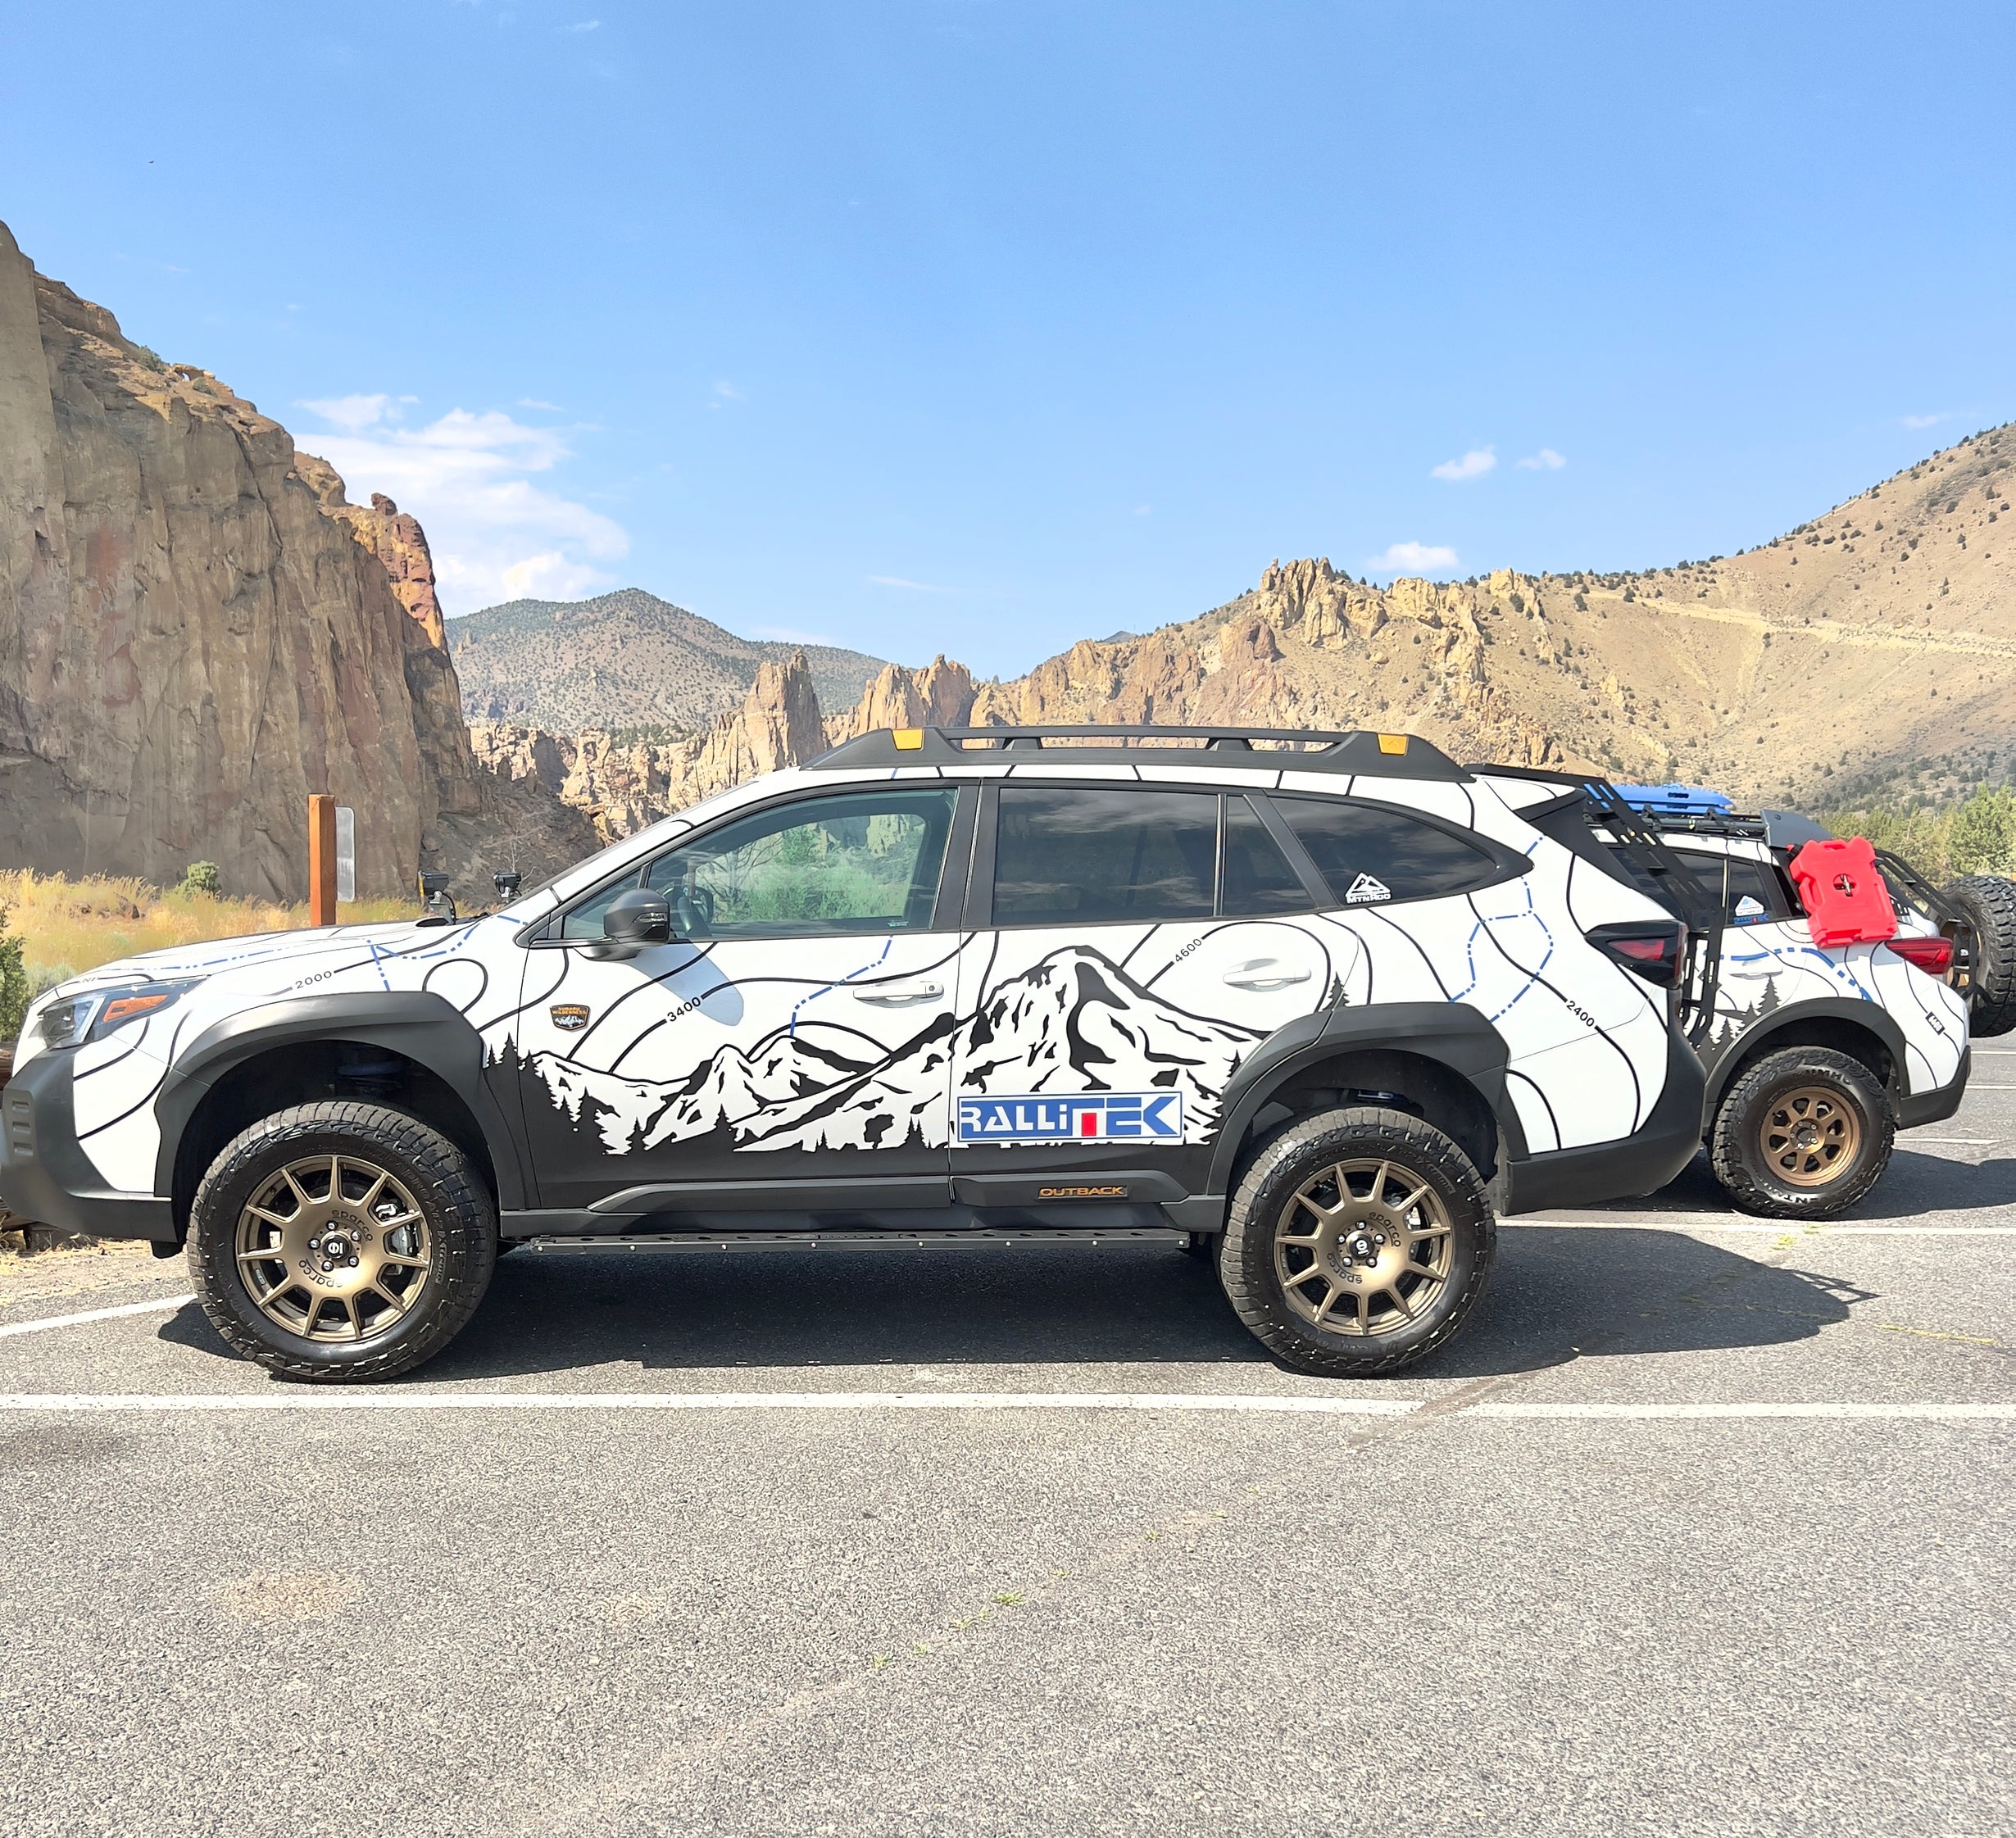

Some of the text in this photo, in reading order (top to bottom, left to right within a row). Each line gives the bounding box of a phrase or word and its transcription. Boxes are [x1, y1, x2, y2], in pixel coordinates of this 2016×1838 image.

[1175, 938, 1201, 962] 4600
[295, 971, 332, 988] 2000
[667, 997, 701, 1022] 3400
[1566, 1001, 1595, 1027] 2400
[1038, 1186, 1124, 1197] OUTBACK
